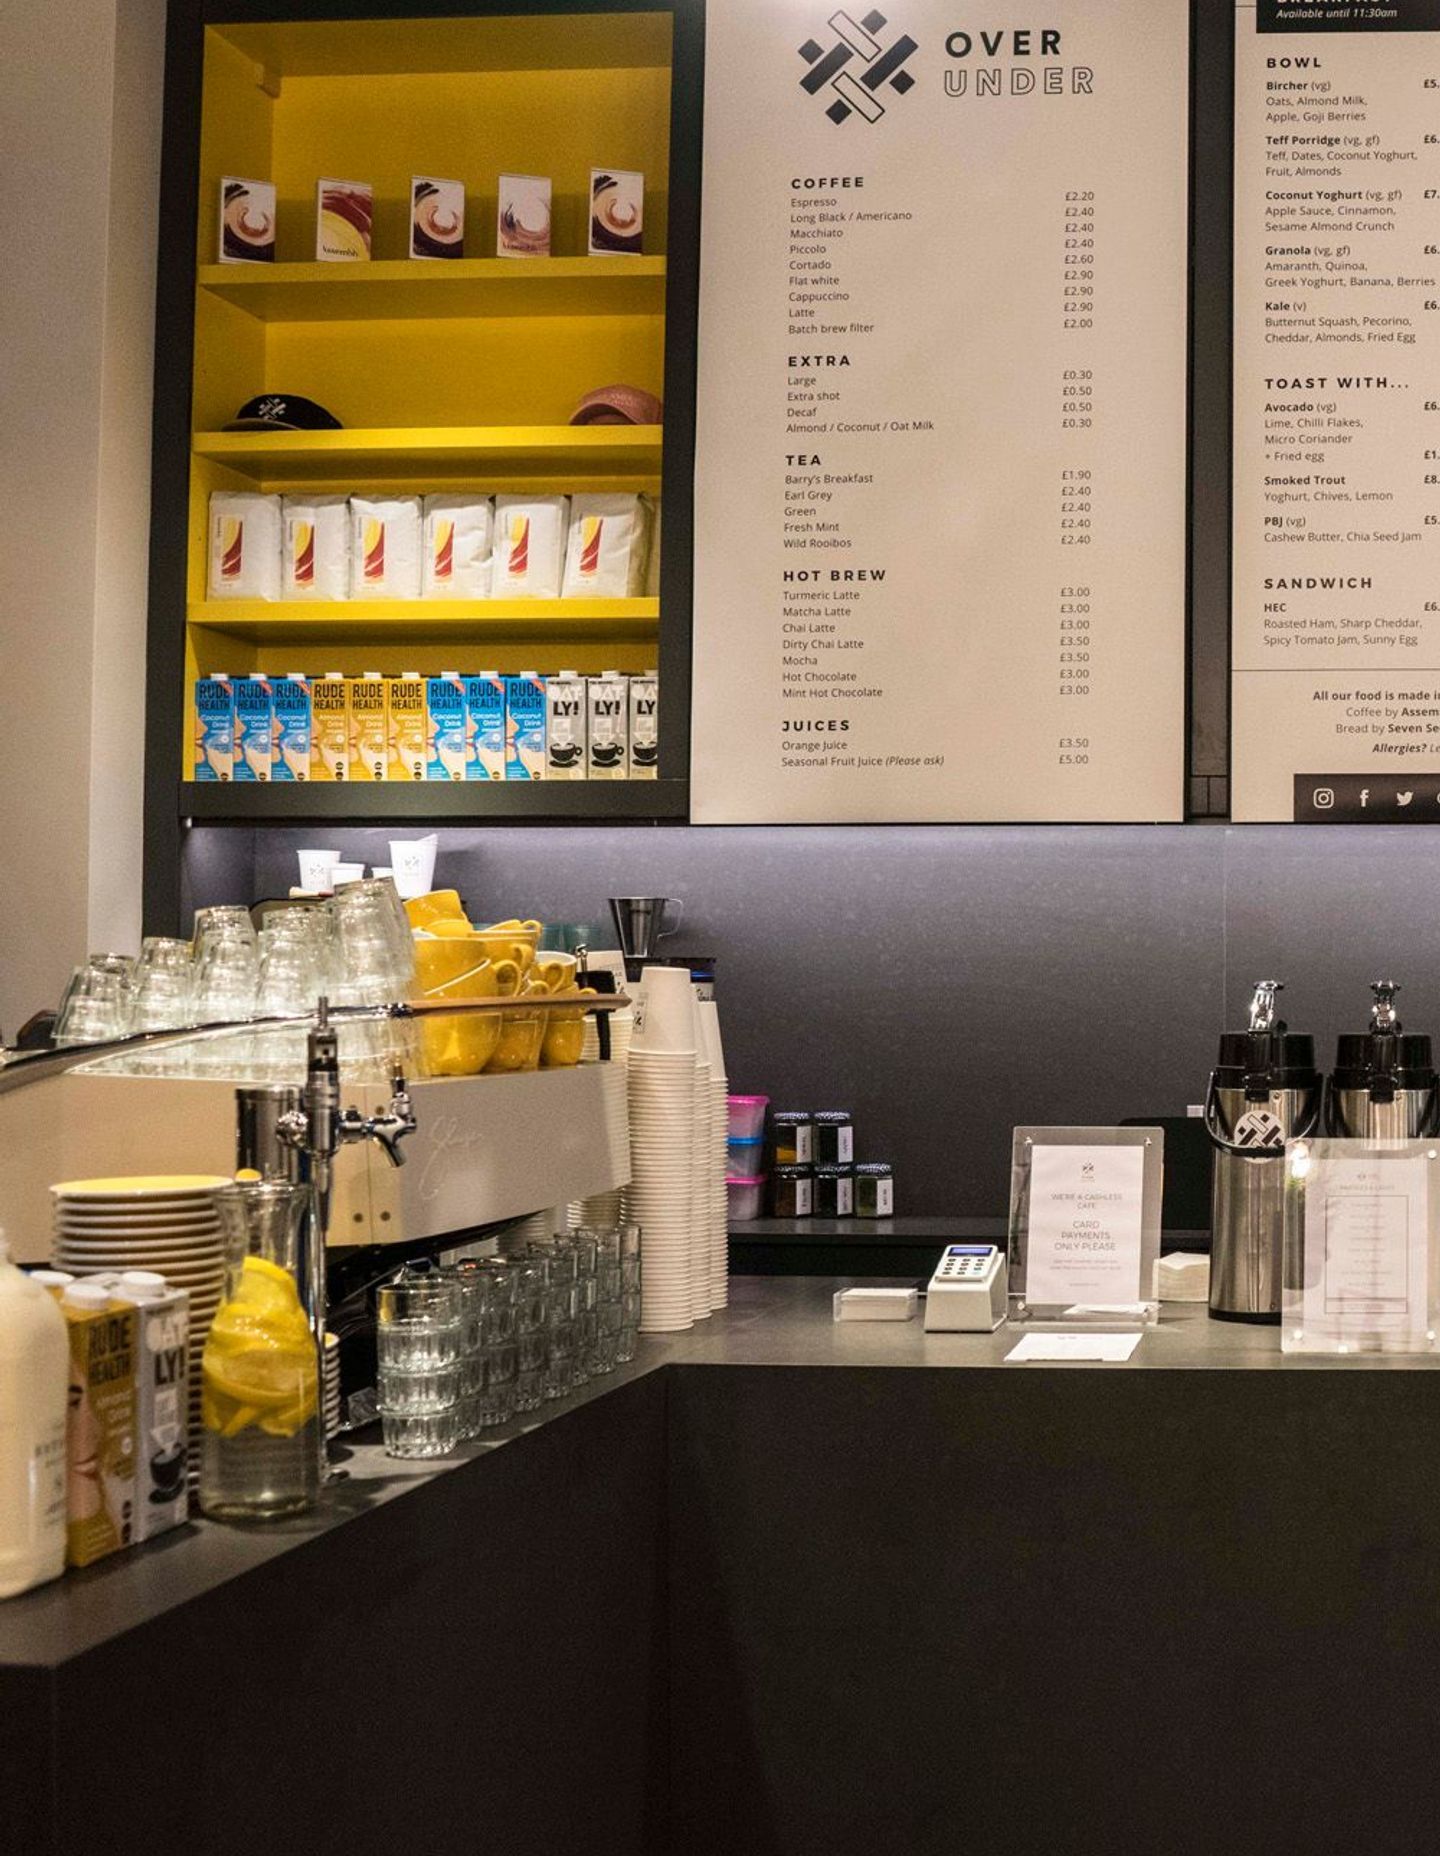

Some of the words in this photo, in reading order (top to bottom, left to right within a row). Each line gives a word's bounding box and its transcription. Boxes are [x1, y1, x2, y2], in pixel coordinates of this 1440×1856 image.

[1276, 9, 1324, 19] Available
[1326, 7, 1350, 18] until
[1354, 7, 1398, 18] 11:30am
[946, 29, 1060, 58] OVER
[1266, 57, 1322, 68] BOWL
[944, 66, 1094, 98] UNDER
[1266, 81, 1308, 91] Bircher
[1266, 135, 1290, 145] Teff
[1292, 135, 1340, 148] Porridge
[792, 177, 864, 190] COFFEE
[790, 198, 838, 209] Espresso
[1066, 191, 1094, 202] £2.20
[1266, 191, 1314, 201] Coconut
[1316, 189, 1362, 202] Yoghurt
[790, 229, 844, 239] Macchiato
[1064, 223, 1094, 233] £2.40
[790, 244, 826, 255] Piccolo
[1064, 238, 1094, 248] £2.40
[788, 260, 832, 271] Cortado
[1064, 254, 1094, 265] £2.60
[788, 276, 808, 286] Flat
[810, 276, 840, 286] white
[1064, 270, 1094, 281] £2.90
[788, 292, 850, 304] Cappuccino
[1064, 286, 1094, 297] £2.90
[788, 308, 814, 318] Latte
[1064, 301, 1094, 313] £2.90
[788, 323, 818, 335] Batch
[820, 324, 848, 334] brew
[850, 322, 874, 333] filter
[1064, 318, 1094, 329] £2.00
[788, 355, 850, 367] EXTRA
[788, 376, 816, 388] Large
[1062, 370, 1094, 381] £0.30
[1264, 377, 1328, 389] TOAST
[1336, 377, 1408, 389] WITH...
[788, 392, 814, 402] Extra
[816, 391, 840, 401] shot
[1062, 385, 1092, 397] £0.50
[786, 407, 818, 418] Decaf
[1062, 401, 1092, 413] £0.50
[786, 454, 820, 466] TEA
[824, 473, 874, 484] Breakfast
[1062, 470, 1092, 480] £1.90
[1264, 475, 1310, 486] Smoked
[1314, 475, 1346, 485] Trout
[1264, 516, 1282, 528] PBJ
[784, 570, 820, 582] HOT
[830, 570, 886, 581] BREW
[1264, 577, 1372, 590] SANDWICH
[784, 590, 830, 601] Turmeric
[832, 591, 860, 600] Latte
[1060, 586, 1090, 598] £3.00
[1264, 603, 1286, 613] HEC
[782, 672, 802, 681] Hot
[804, 672, 856, 682] Chocolate
[1060, 668, 1090, 679] £3.00
[314, 683, 345, 698] RUDE
[352, 683, 383, 698] RUDE
[391, 683, 422, 698] RUDE
[1312, 690, 1328, 701] All
[1332, 692, 1352, 701] our
[1356, 690, 1382, 701] food
[1384, 690, 1394, 701] is
[1398, 690, 1430, 701] made
[314, 699, 345, 710] HEALTH
[352, 699, 383, 710] HEALTH
[391, 699, 422, 710] HEALTH
[510, 699, 541, 709] HEALTH
[553, 701, 578, 716] LY!
[594, 701, 620, 716] LY!
[782, 720, 850, 732] JUICES
[782, 740, 820, 753] Orange
[822, 741, 848, 753] Juice
[1058, 737, 1090, 748] £3.50
[1372, 742, 1428, 756] Allergies?
[782, 756, 828, 767] Seasonal
[830, 756, 856, 767] Fruit
[858, 756, 882, 769] Juice
[886, 755, 922, 767] (Please
[924, 755, 944, 767] ask)
[1058, 754, 1090, 765] £5.00
[1073, 1221, 1100, 1229] CARD
[1061, 1231, 1110, 1240] PAYMENTS
